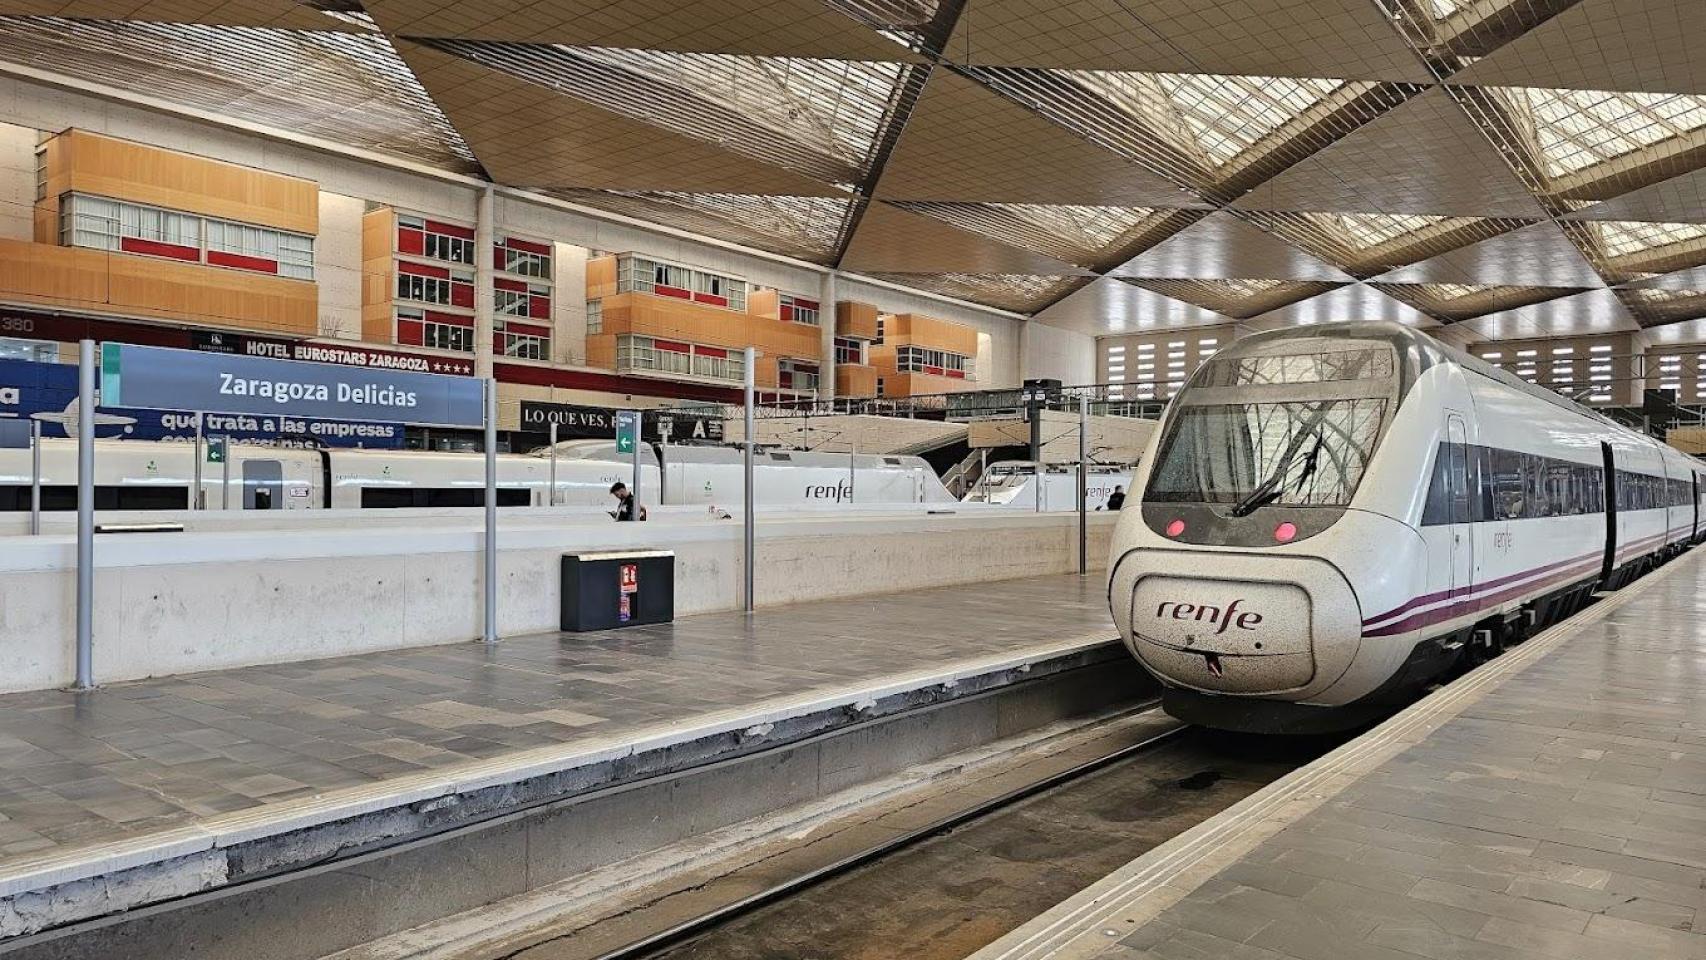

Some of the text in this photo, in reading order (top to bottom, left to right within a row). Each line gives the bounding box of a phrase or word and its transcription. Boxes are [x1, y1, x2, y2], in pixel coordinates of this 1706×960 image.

[246, 341, 290, 359] HOTEL
[294, 346, 366, 365] EUROSTARS
[368, 353, 430, 372] ZARAGOZA
[220, 373, 417, 408] Zaragoza Delicias
[161, 413, 395, 439] que trata a las empresas
[525, 408, 545, 424] LO
[547, 410, 577, 425] QUE
[805, 478, 853, 503] renfe
[1085, 482, 1111, 502] renfe
[1157, 599, 1263, 634] renfe
